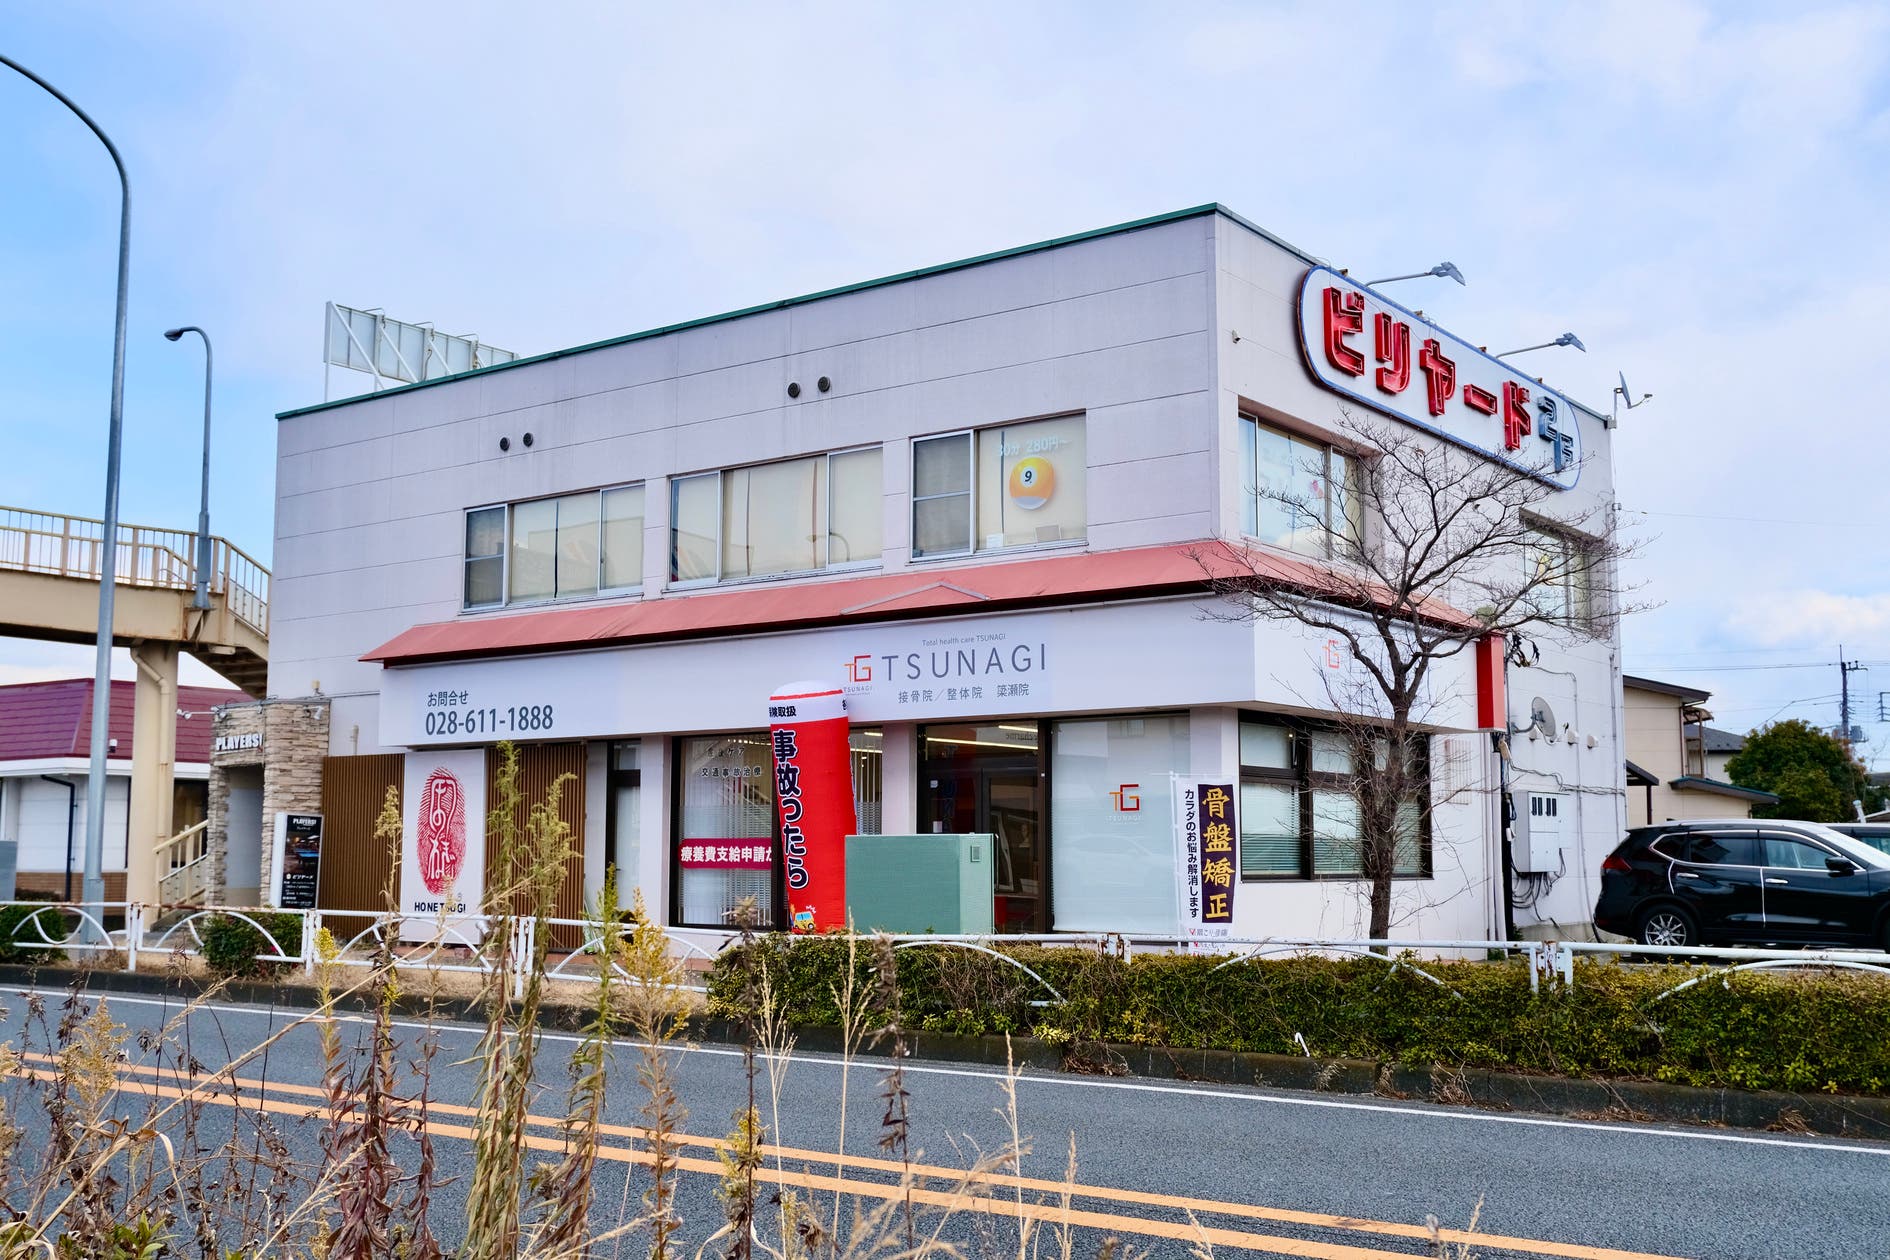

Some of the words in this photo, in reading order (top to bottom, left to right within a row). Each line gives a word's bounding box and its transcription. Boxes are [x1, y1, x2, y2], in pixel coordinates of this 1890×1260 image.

[1323, 287, 1531, 450] ビリヤード
[1537, 396, 1573, 473] 2F
[922, 638, 938, 647] Total
[939, 636, 960, 646] health
[960, 636, 975, 644] care
[976, 633, 1006, 642] TSUNAGI
[881, 643, 1046, 681] TSUNAGI
[427, 689, 469, 707] お問合せ
[425, 704, 554, 736] 028-611-1888
[772, 728, 809, 890] 事故ったら
[1184, 788, 1199, 919] カラダのお悩み解消します
[1201, 787, 1236, 919] 骨盤矯正
[414, 902, 466, 914] HONETUGI
